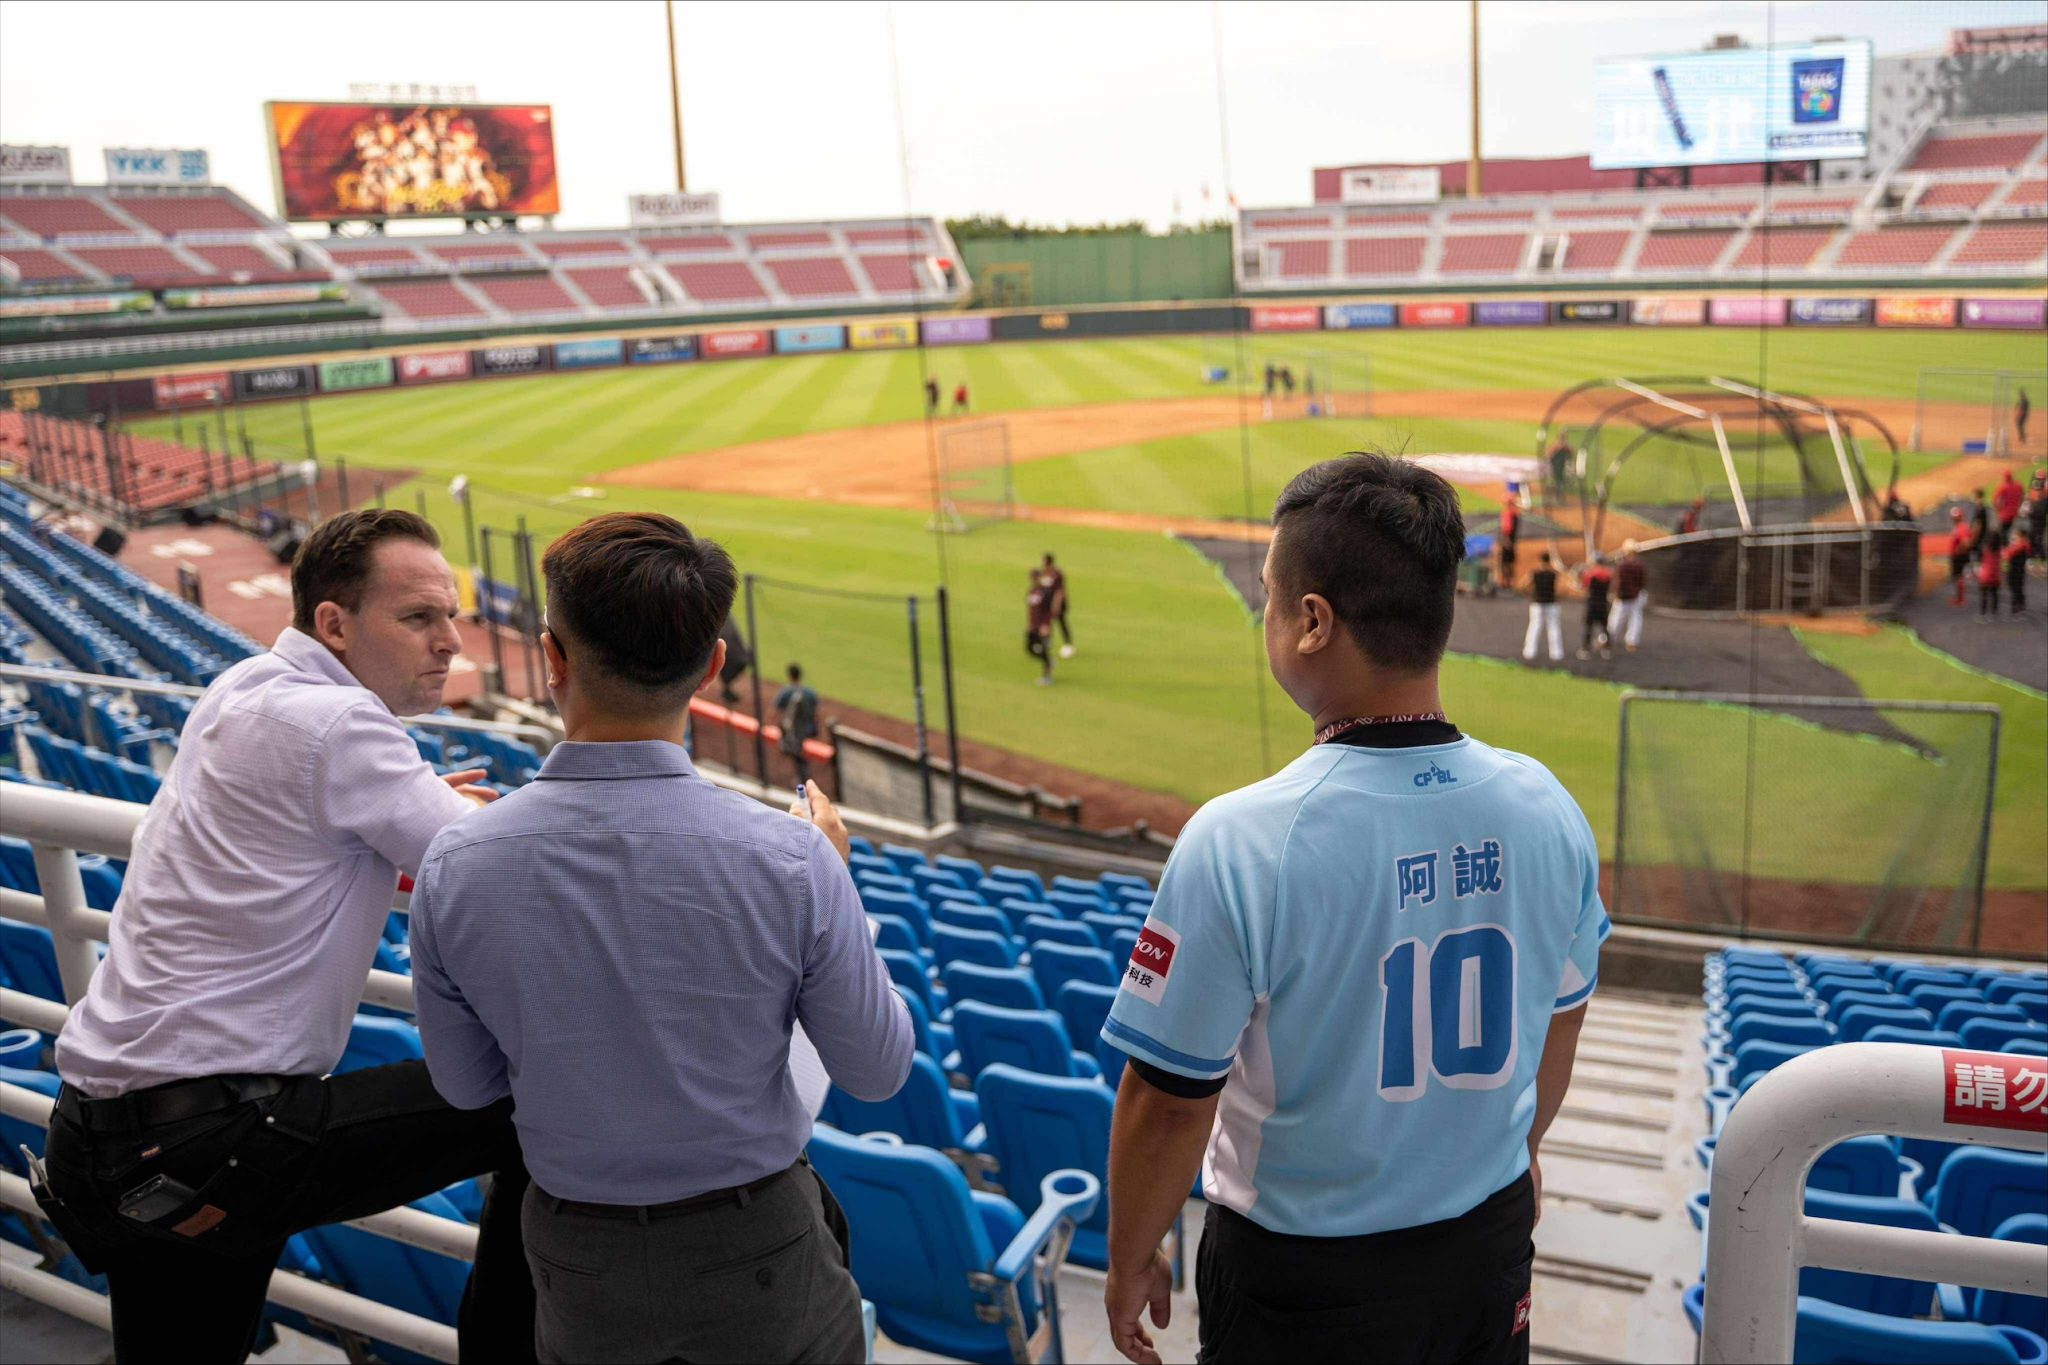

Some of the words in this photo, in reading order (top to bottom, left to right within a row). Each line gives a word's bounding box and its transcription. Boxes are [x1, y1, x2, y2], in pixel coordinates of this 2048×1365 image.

[112, 155, 165, 174] YKK
[1413, 768, 1458, 787] CPBL
[1379, 925, 1515, 1096] 10
